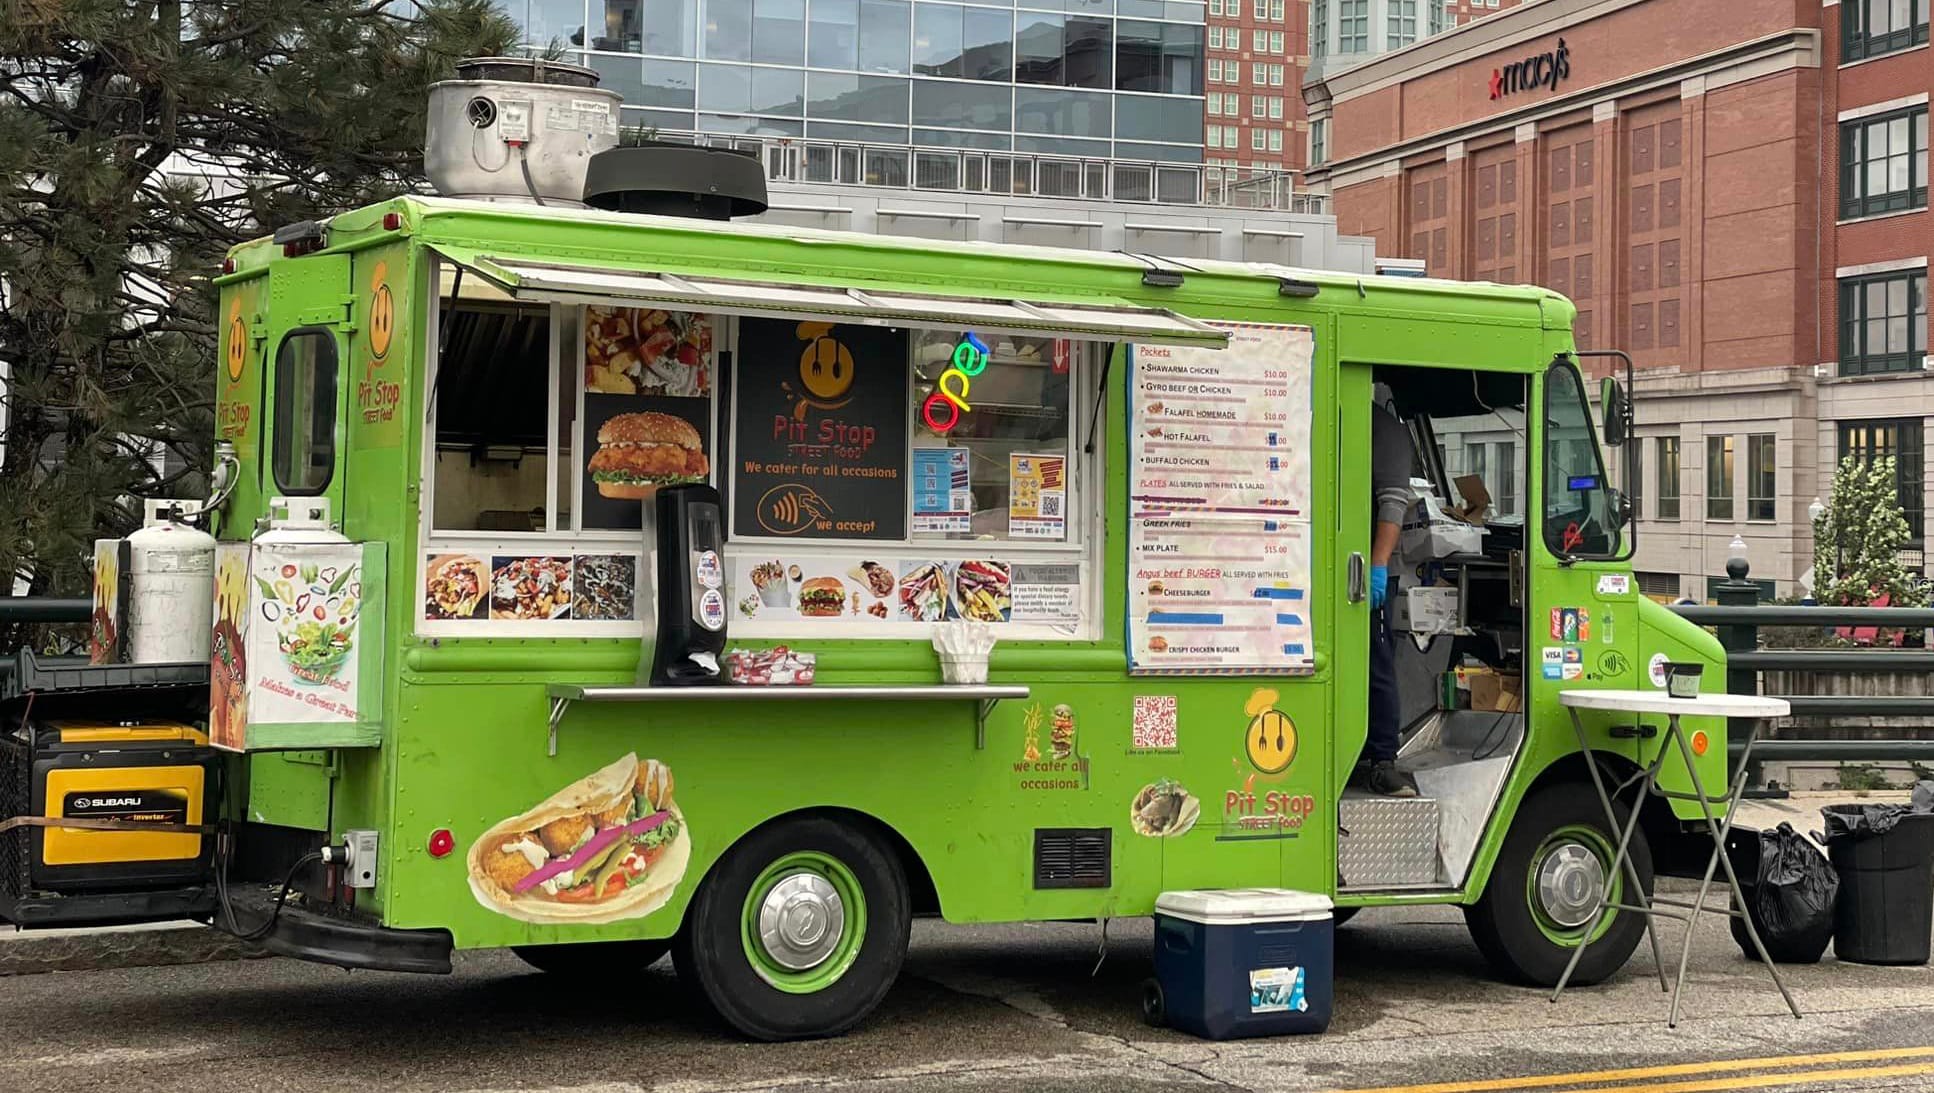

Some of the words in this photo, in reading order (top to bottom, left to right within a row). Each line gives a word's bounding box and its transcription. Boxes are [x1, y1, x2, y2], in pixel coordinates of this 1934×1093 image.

[1503, 37, 1569, 96] macy's
[1190, 366, 1219, 374] CHICKEN
[358, 382, 372, 408] Pit
[375, 380, 399, 411] Stop
[1200, 385, 1231, 394] CHICKEN
[230, 401, 250, 428] Stop
[773, 415, 808, 441] Pit
[818, 418, 876, 451] Stop
[1164, 433, 1178, 441] HOT
[745, 462, 761, 473] We
[766, 463, 798, 474] cater
[802, 463, 819, 475] for
[823, 465, 838, 477] all
[842, 467, 897, 478] occasions
[816, 521, 832, 530] we
[836, 520, 876, 533] accept
[1136, 568, 1160, 578] Angus
[1164, 568, 1183, 578] beef
[1186, 569, 1221, 578] BURGER
[1014, 762, 1030, 772] we
[1034, 761, 1066, 772] cater
[1020, 778, 1079, 789] occasions
[92, 798, 141, 807] SUBARU
[1226, 790, 1256, 816] Pit
[1264, 790, 1314, 820] Stop
